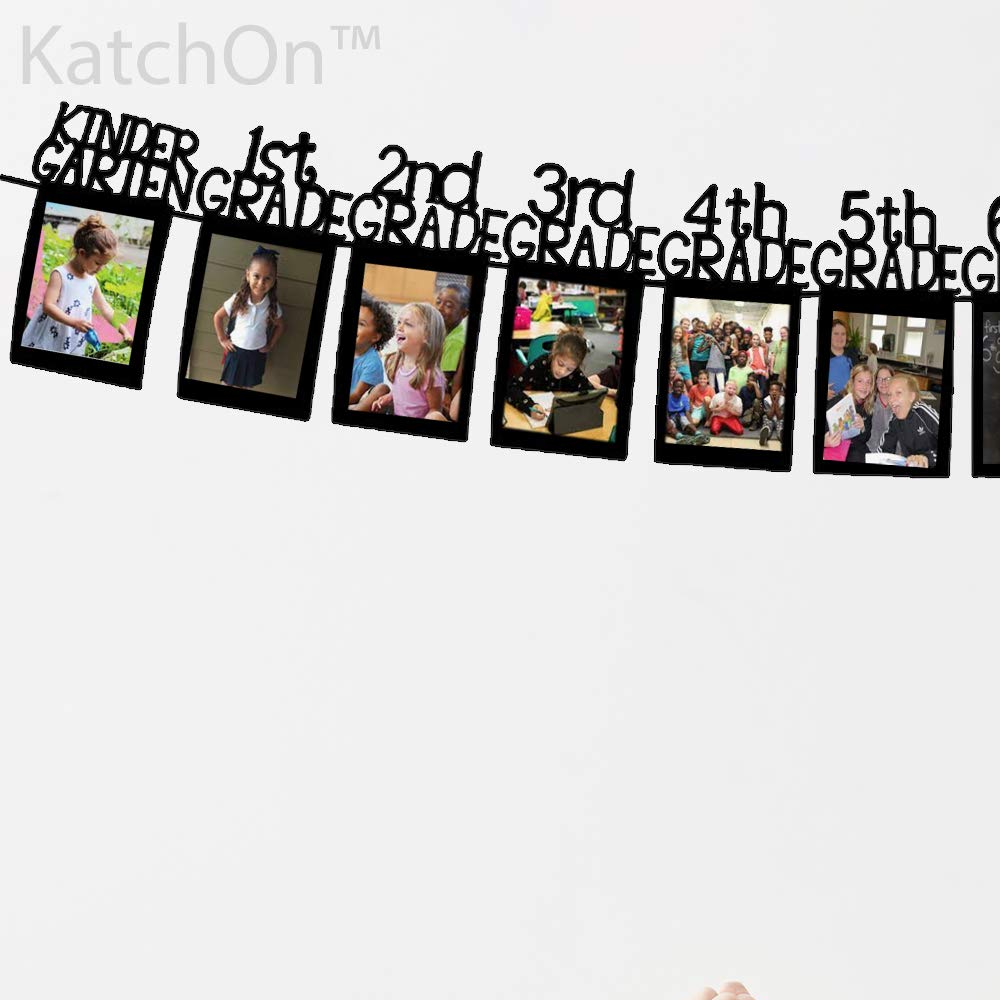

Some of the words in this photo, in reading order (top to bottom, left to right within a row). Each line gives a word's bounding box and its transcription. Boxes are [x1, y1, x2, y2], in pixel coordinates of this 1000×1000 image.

[50, 101, 200, 170] KINDER
[249, 125, 317, 186] 1st
[32, 138, 198, 212] GARTEN
[196, 166, 353, 240] GRADE
[372, 144, 483, 211] 2nd
[528, 162, 635, 228] 3rd
[348, 192, 508, 261] GRADE
[684, 182, 787, 240] 4th
[838, 188, 936, 246] 5th
[503, 213, 661, 276] GRADE
[657, 230, 812, 290] GRADE
[810, 239, 962, 295] GRADE
[984, 320, 1000, 333] first
